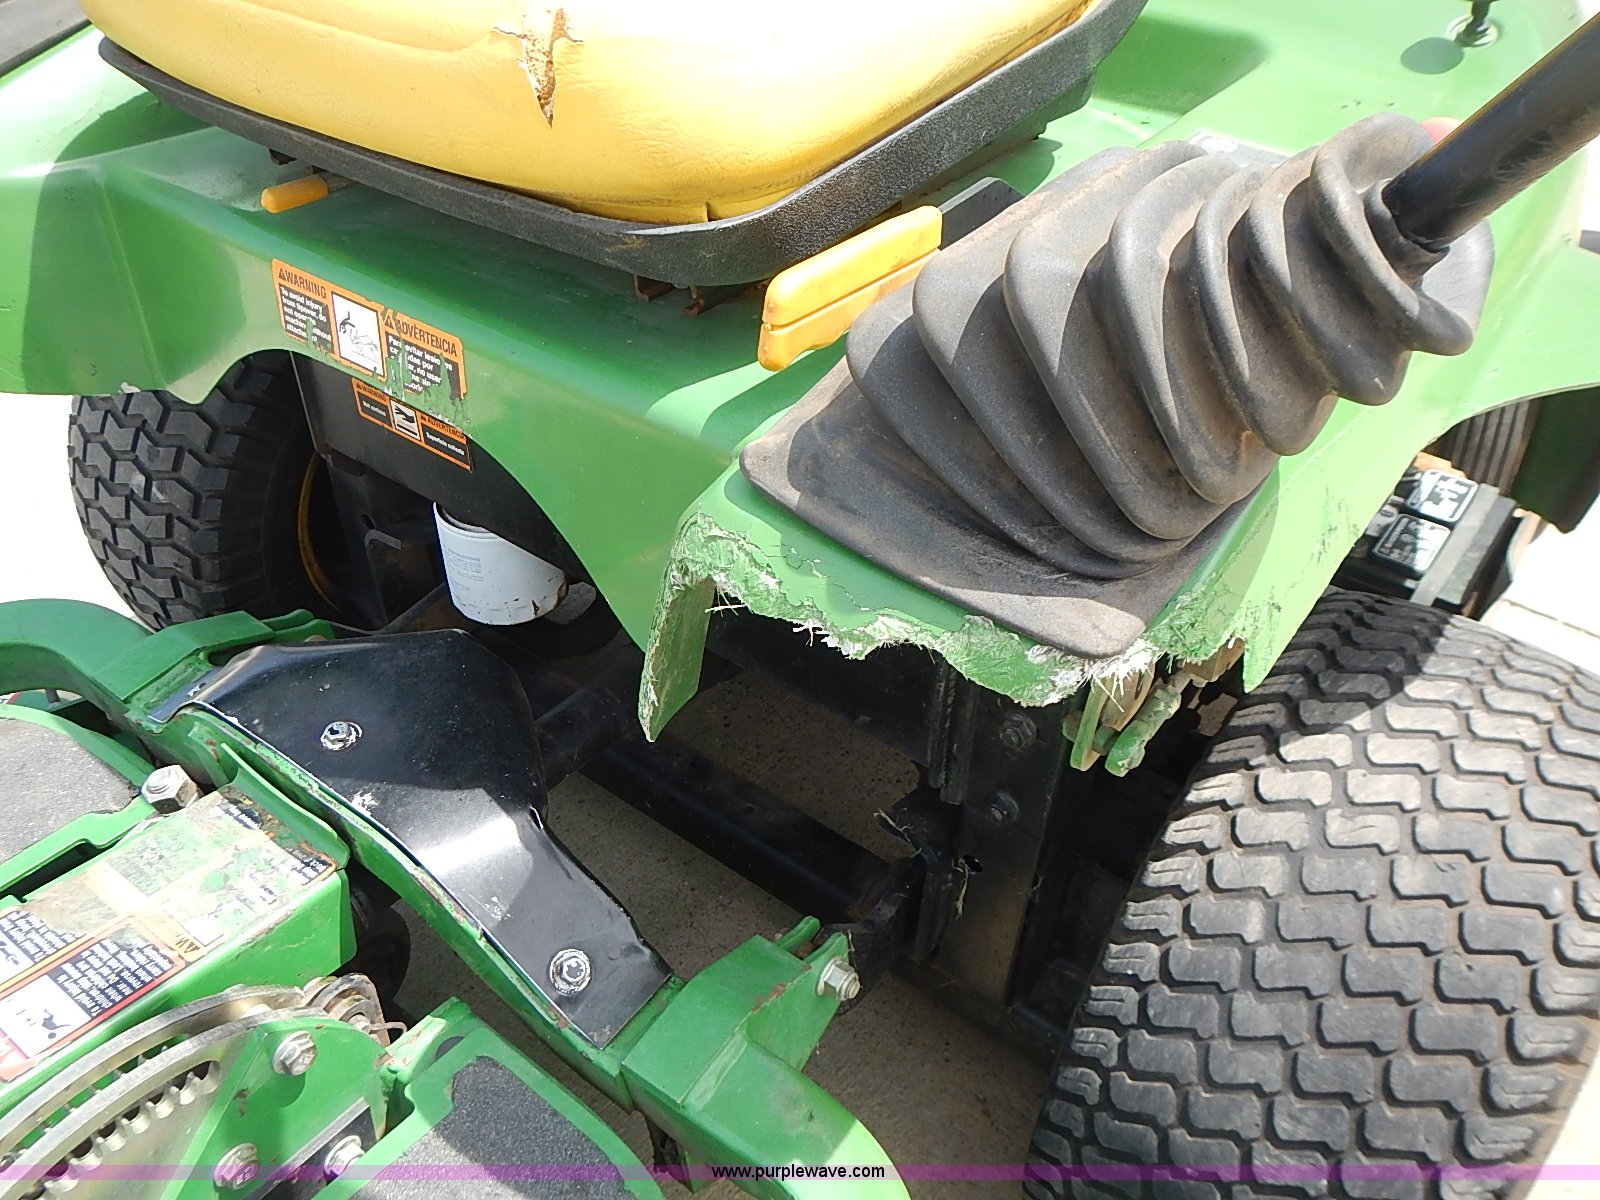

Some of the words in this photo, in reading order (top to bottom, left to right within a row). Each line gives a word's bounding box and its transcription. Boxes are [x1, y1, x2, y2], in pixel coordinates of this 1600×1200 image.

[284, 270, 327, 299] WARNING
[280, 286, 289, 296] To
[289, 291, 305, 303] avoid
[305, 297, 324, 314] injury
[282, 296, 296, 307] from
[319, 313, 327, 323] do
[283, 306, 294, 315] not
[361, 383, 387, 403] WARNING
[427, 416, 466, 441] ADVERTENCIA
[74, 958, 91, 972] are
[85, 953, 104, 969] mow
[103, 956, 124, 973] Look
[143, 960, 164, 977] carry
[53, 972, 69, 984] to
[82, 967, 110, 991] children
[96, 964, 112, 977] not
[104, 972, 120, 984] Do
[117, 967, 143, 990] reverse.
[132, 966, 153, 984] when
[59, 976, 85, 997] injury
[102, 985, 123, 1003] when
[113, 979, 133, 996] near.
[73, 991, 97, 1010] avoid
[85, 985, 114, 1010] children,
[87, 1004, 104, 1017] To
